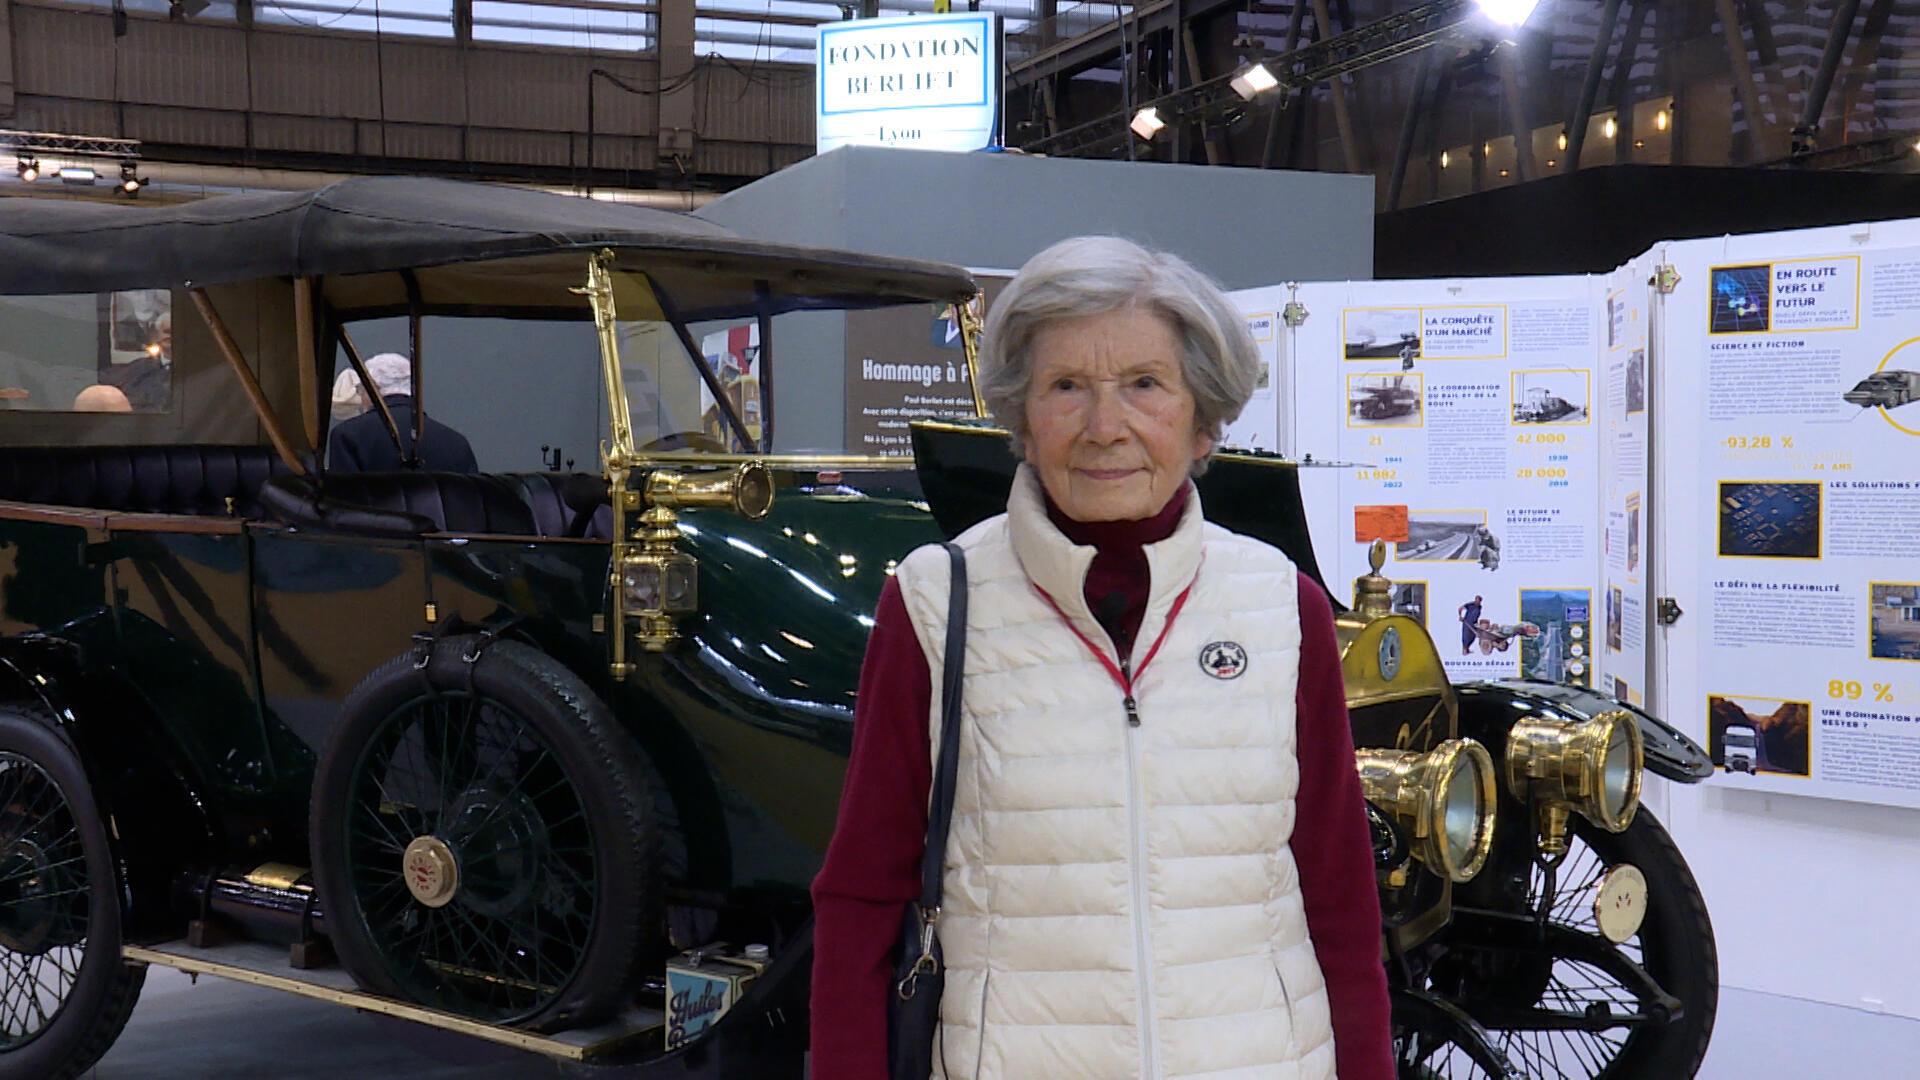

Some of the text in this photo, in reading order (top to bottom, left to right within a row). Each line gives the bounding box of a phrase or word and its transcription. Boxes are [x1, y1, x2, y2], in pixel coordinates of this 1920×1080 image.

[829, 37, 979, 65] FONDATION
[847, 70, 960, 94] BERLIET
[879, 126, 921, 145] Lyon
[1776, 267, 1837, 280] EN ROUTE
[1776, 281, 1825, 294] VERS LE
[1775, 298, 1816, 308] FUTUR
[1425, 314, 1495, 326] LA CONQUÊTE
[1425, 326, 1493, 336] D'UN MARCHÉ
[862, 359, 942, 388] Hommage
[946, 361, 957, 382] à
[1369, 435, 1382, 446] 21
[1516, 433, 1566, 444] 42 000
[1781, 437, 1794, 449] %
[1536, 468, 1567, 479] 000
[1728, 580, 1748, 589] DÉFI
[1782, 583, 1840, 592] FLEXIBILITÉ
[1828, 679, 1862, 700] 89
[1872, 683, 1894, 702] %
[1845, 711, 1911, 722] DOMINATION
